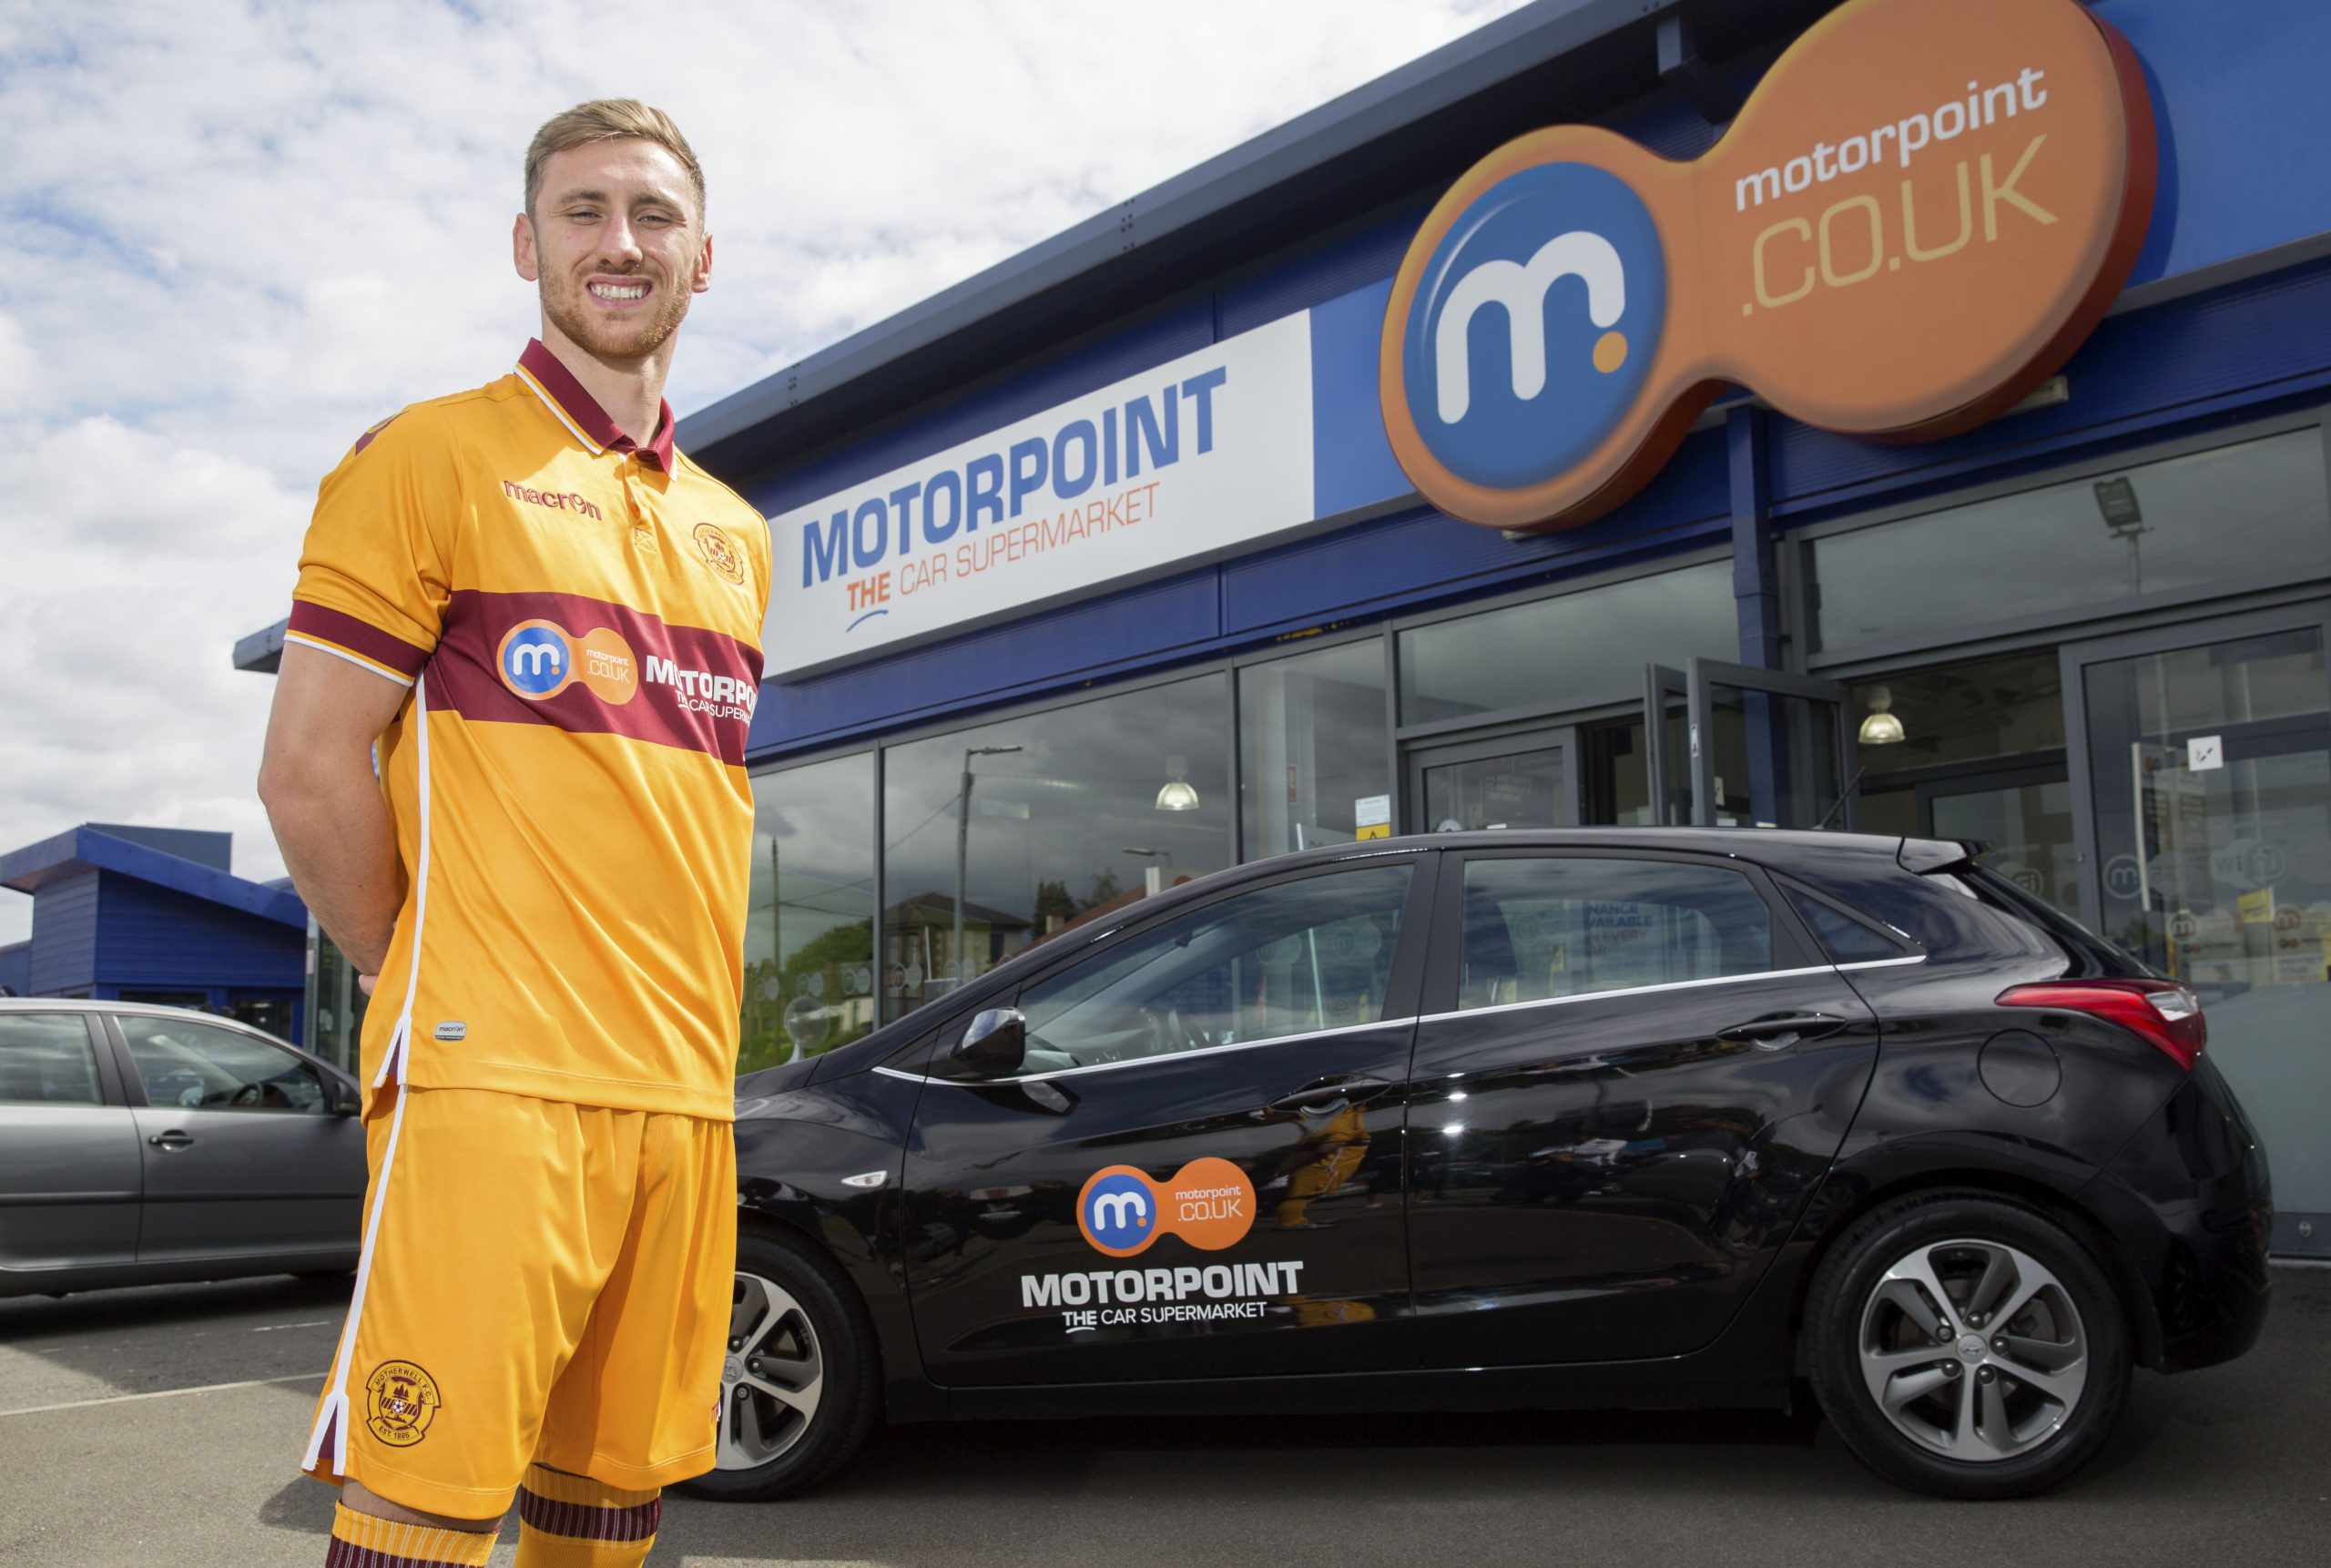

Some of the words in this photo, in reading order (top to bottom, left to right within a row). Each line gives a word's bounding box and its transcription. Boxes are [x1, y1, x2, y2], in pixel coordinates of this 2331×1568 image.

[1736, 67, 2048, 212] motorpoint
[1742, 134, 2060, 317] .CO.UK
[802, 365, 1227, 589] MOTORPOINT
[504, 480, 602, 521] macron
[847, 572, 891, 611] THE
[899, 552, 947, 596] CAR
[955, 482, 1161, 578] SUPERMARKET
[585, 648, 630, 667] motorpoint
[1176, 1186, 1242, 1200] motorpoint
[1178, 1198, 1243, 1222] .CO.UK
[1021, 1260, 1304, 1308] MOTORPOINT
[1062, 1309, 1097, 1327] THE
[1101, 1308, 1136, 1325] CAR
[1140, 1301, 1267, 1323] SUPERMARKET
[375, 1368, 422, 1387] MOTHERWELL
